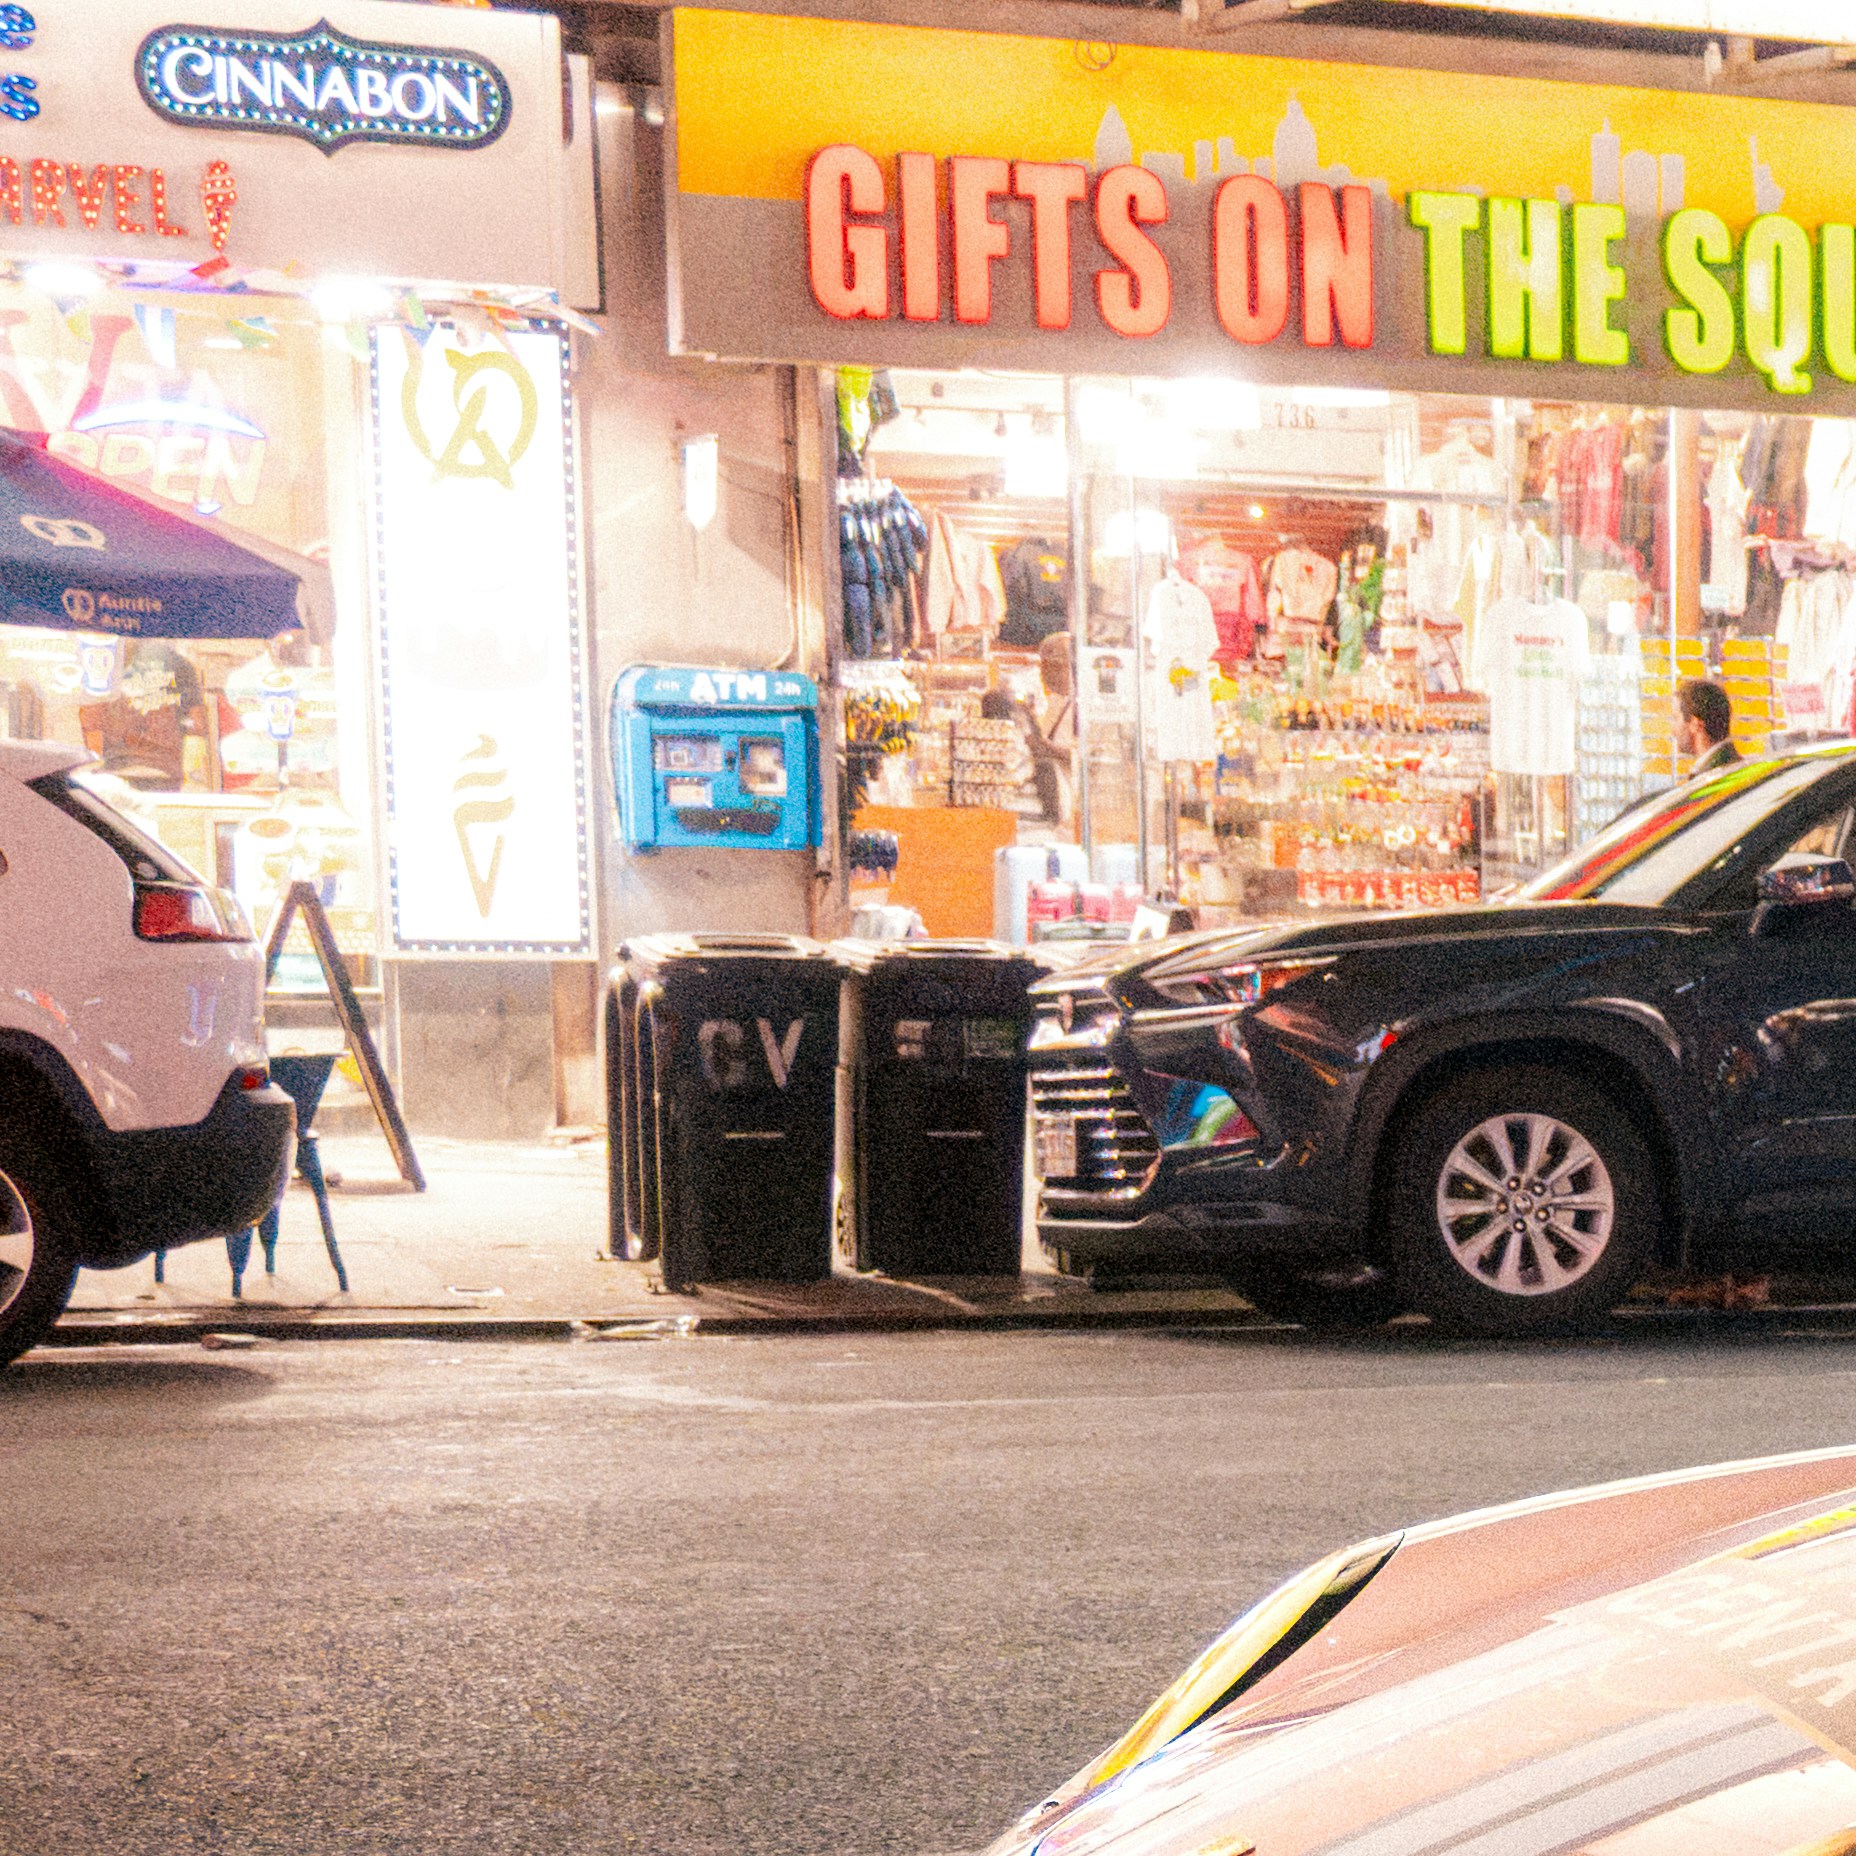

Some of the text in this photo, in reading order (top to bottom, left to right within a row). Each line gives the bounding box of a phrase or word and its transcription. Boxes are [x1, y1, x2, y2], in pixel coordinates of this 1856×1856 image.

[163, 48, 483, 125] CINNABON
[806, 144, 1171, 338] GIFTS
[1214, 174, 1375, 349] ON
[1406, 190, 1631, 366] THE
[1273, 402, 1318, 431] 736
[690, 671, 767, 703] ATM
[773, 680, 803, 696] 24h
